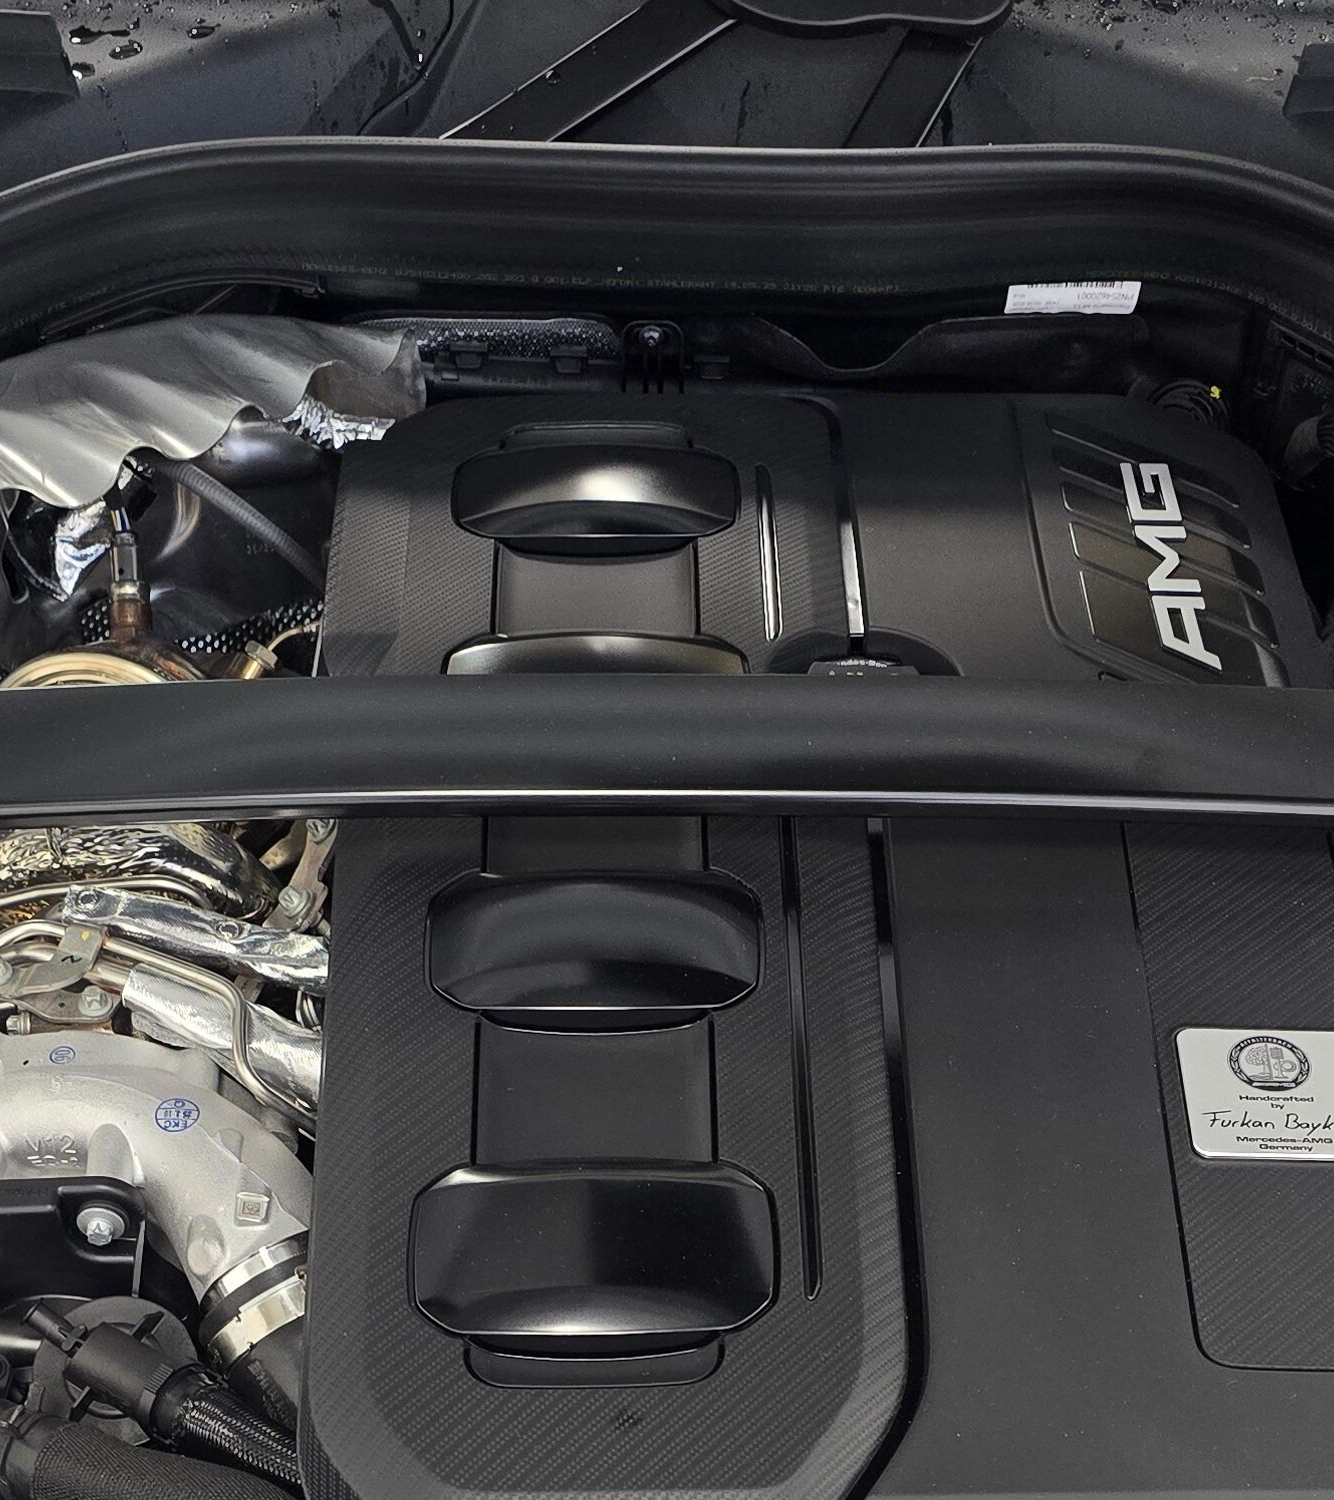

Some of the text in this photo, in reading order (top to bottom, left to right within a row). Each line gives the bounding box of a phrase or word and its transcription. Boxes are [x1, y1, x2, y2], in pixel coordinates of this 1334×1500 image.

[1122, 461, 1223, 672] AMG
[1238, 1094, 1315, 1103] Handcrafted
[164, 1120, 187, 1129] EKC
[1200, 1109, 1276, 1131] Furkan
[1236, 1135, 1334, 1145] Mercedes-AMG
[1258, 1144, 1314, 1153] Germany
